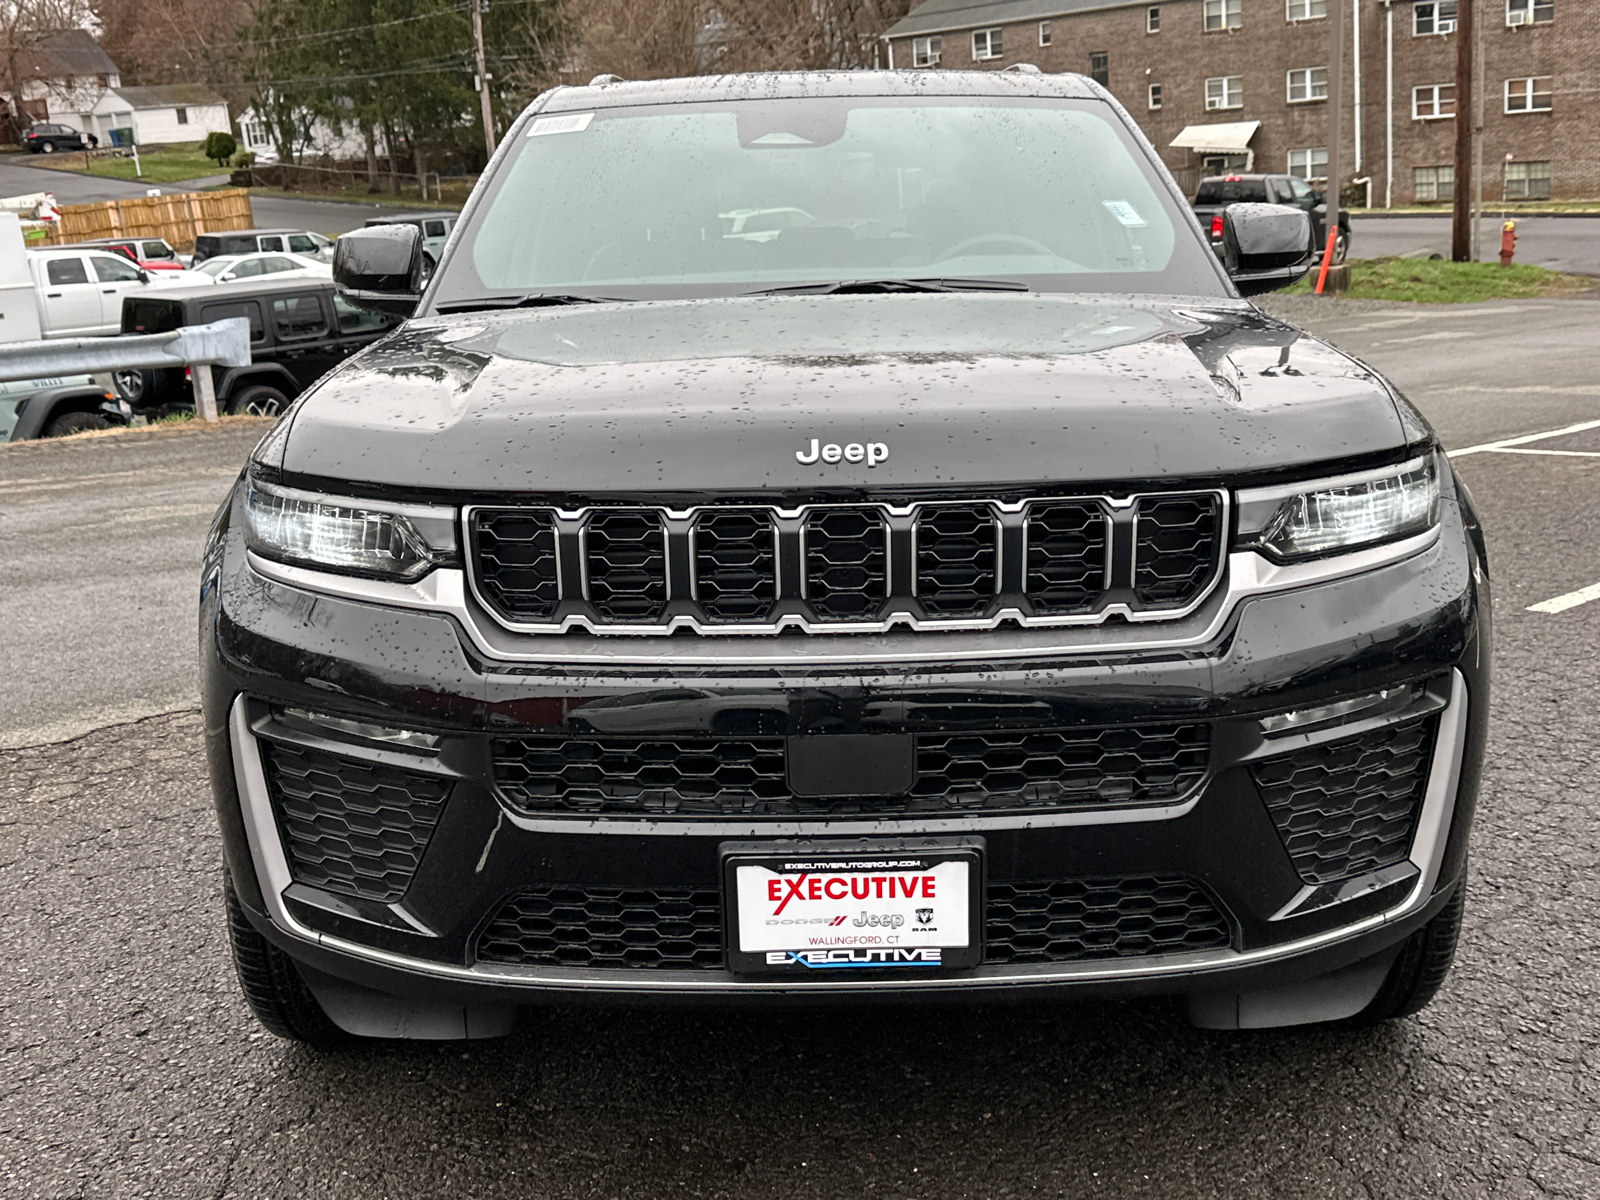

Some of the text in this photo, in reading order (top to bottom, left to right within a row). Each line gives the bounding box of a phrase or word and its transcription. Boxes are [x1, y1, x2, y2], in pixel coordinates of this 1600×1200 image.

[796, 438, 889, 468] Jeep
[784, 860, 921, 870] EXECUTIVEAUTOGROUP.COM
[768, 873, 936, 916] EXECUTIVE
[766, 918, 836, 926] DODGE
[852, 911, 905, 930] Jeep
[808, 935, 900, 946] WALLINGFORD, CT
[765, 948, 942, 966] EXECUTIVE
